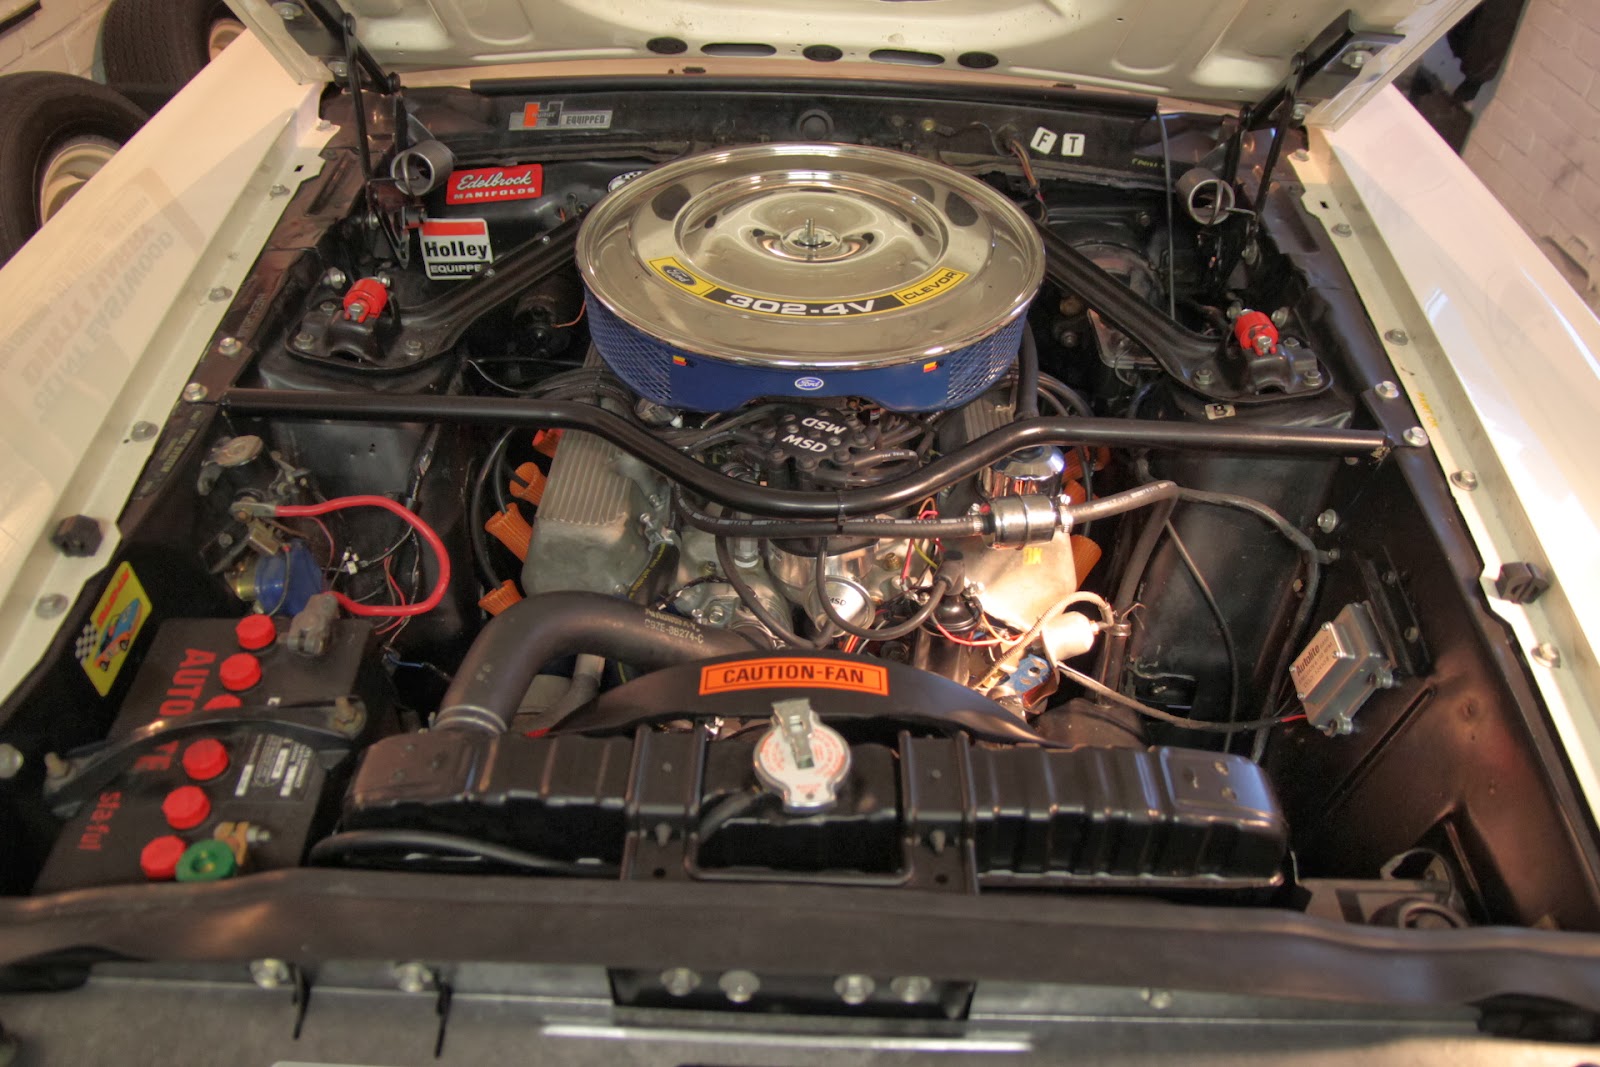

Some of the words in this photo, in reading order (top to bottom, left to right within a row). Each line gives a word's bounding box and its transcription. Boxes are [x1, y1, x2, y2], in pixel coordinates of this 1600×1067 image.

[566, 114, 606, 125] EQUIPPED
[1036, 131, 1051, 148] F
[1069, 135, 1080, 153] T
[456, 170, 532, 190] Edelbrock
[453, 187, 536, 200] MANIFOLDS
[423, 240, 488, 260] Holley
[430, 263, 482, 274] EQUIPPE
[666, 267, 691, 283] Ford
[903, 271, 958, 301] CLEVOR
[725, 294, 875, 316] 302-4V
[797, 378, 822, 389] Ford
[801, 416, 847, 435] MSD
[782, 434, 828, 453] MSD
[1295, 644, 1321, 676] Autolite
[723, 664, 865, 685] CAUTION-FAN
